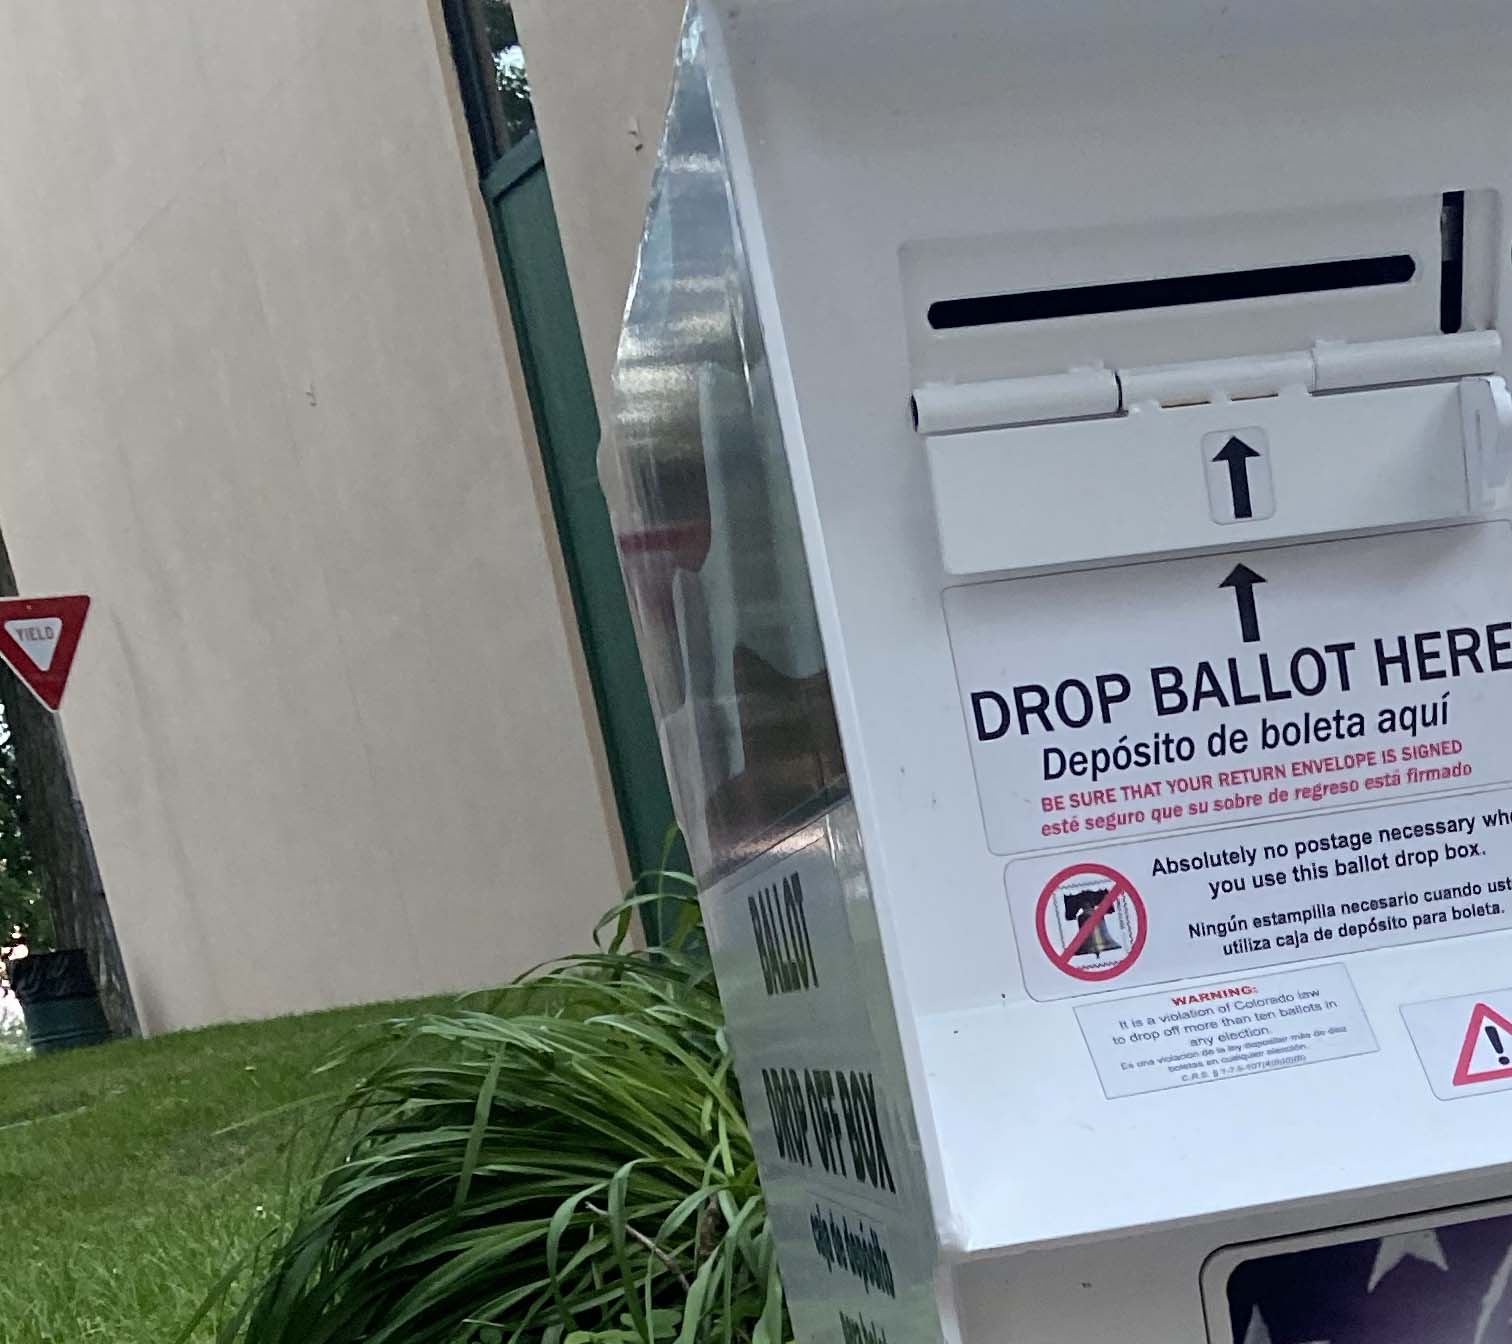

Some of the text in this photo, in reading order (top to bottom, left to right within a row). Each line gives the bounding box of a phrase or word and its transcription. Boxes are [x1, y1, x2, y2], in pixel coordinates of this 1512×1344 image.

[16, 626, 55, 642] YIELD
[971, 673, 1131, 741] DROP
[1151, 642, 1356, 716] BALLOT
[1043, 691, 1450, 782] Depósito de boleta aquí
[1041, 739, 1463, 813] BE SURE THAT YOUR RETURN ENVELOPE IS SIGNED
[1085, 811, 1145, 831] seguro
[1151, 805, 1183, 824] que
[1188, 800, 1209, 816] su
[1213, 791, 1263, 812] sobre
[1268, 787, 1288, 805] de
[1294, 780, 1359, 802] regreso
[1407, 762, 1473, 785] firmado
[1152, 845, 1257, 876] Absolutely
[1264, 844, 1288, 860] no
[1295, 831, 1373, 859] postage
[1379, 816, 1476, 843] necessary
[1208, 842, 1487, 900] you use this ballot drop box.
[1188, 914, 1248, 938] Ningún
[1253, 903, 1336, 928] estampilla
[1341, 891, 1419, 915] necesario
[1423, 882, 1482, 902] cuando
[1223, 902, 1505, 956] utiliza caja de depósito para boleta.
[1112, 1000, 1337, 1045] to drop off more than ten ballots in
[1131, 1018, 1143, 1028] is
[1147, 1017, 1156, 1025] a
[1159, 1006, 1215, 1023] violation
[1218, 1002, 1231, 1014] of
[1234, 993, 1295, 1010] Colorado
[1171, 985, 1258, 1006] WARNING:
[1190, 1036, 1213, 1047] any
